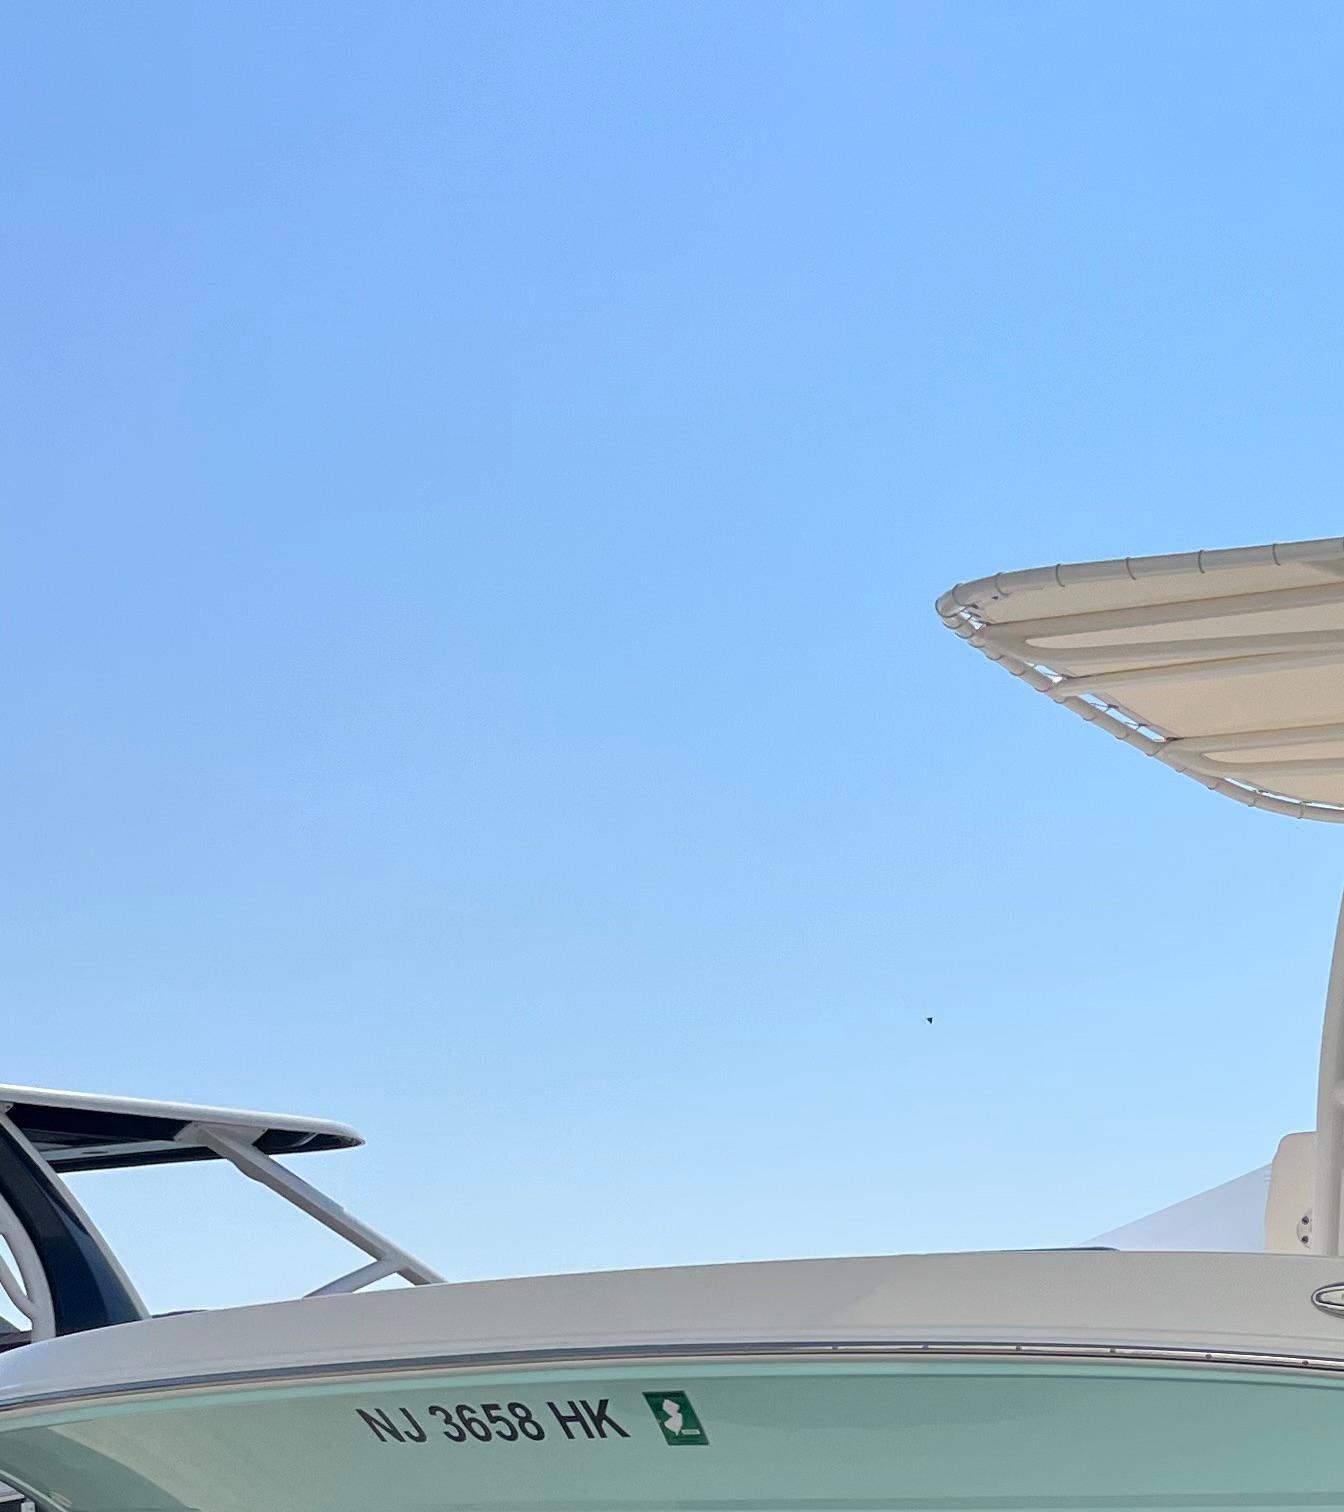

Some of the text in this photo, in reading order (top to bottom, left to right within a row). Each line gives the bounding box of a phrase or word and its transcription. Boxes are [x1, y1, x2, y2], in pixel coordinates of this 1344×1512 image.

[355, 1399, 631, 1442] NJ 3658 HK
